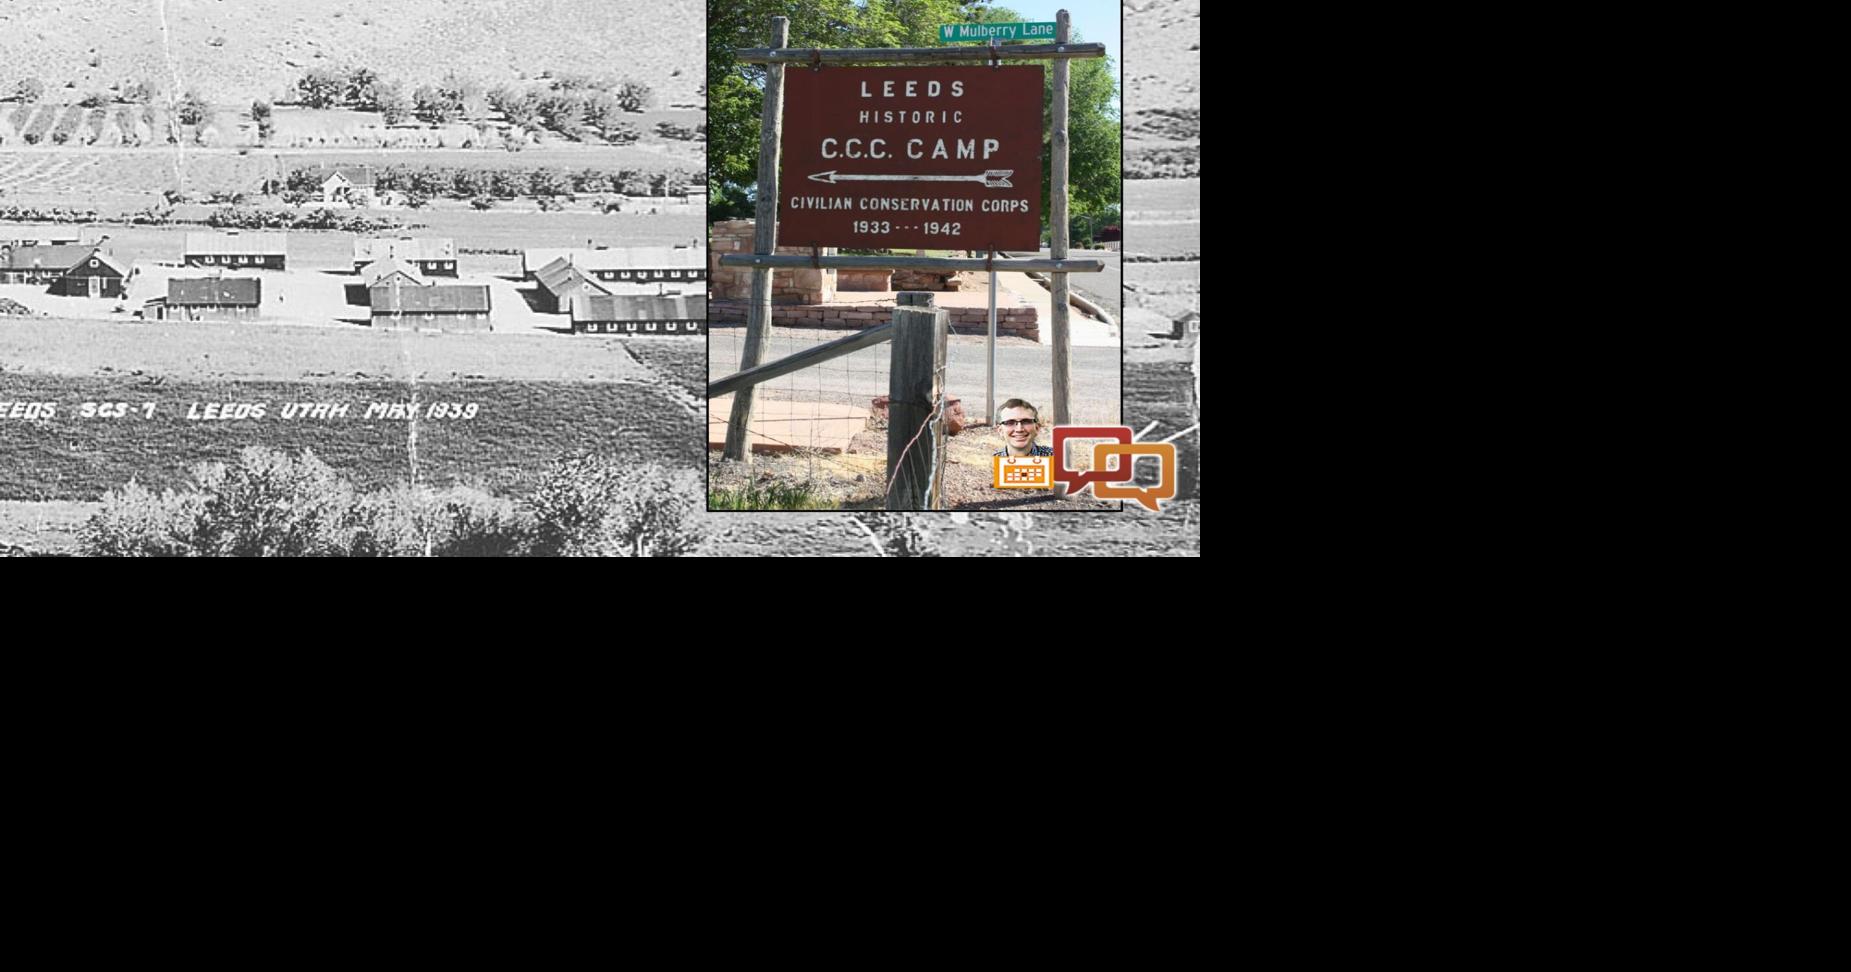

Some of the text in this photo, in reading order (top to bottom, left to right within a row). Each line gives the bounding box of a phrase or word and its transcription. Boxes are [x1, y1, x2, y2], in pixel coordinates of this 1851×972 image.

[943, 23, 1054, 40] W Mulberry Lane
[861, 80, 965, 98] LEEDS
[859, 110, 963, 124] HISTORIC
[821, 138, 1000, 160] C.C.C. CAMP
[790, 196, 1029, 213] CIVILIAN CONSERVATION CORPS
[853, 220, 890, 234] 1933
[924, 222, 961, 235] 1942
